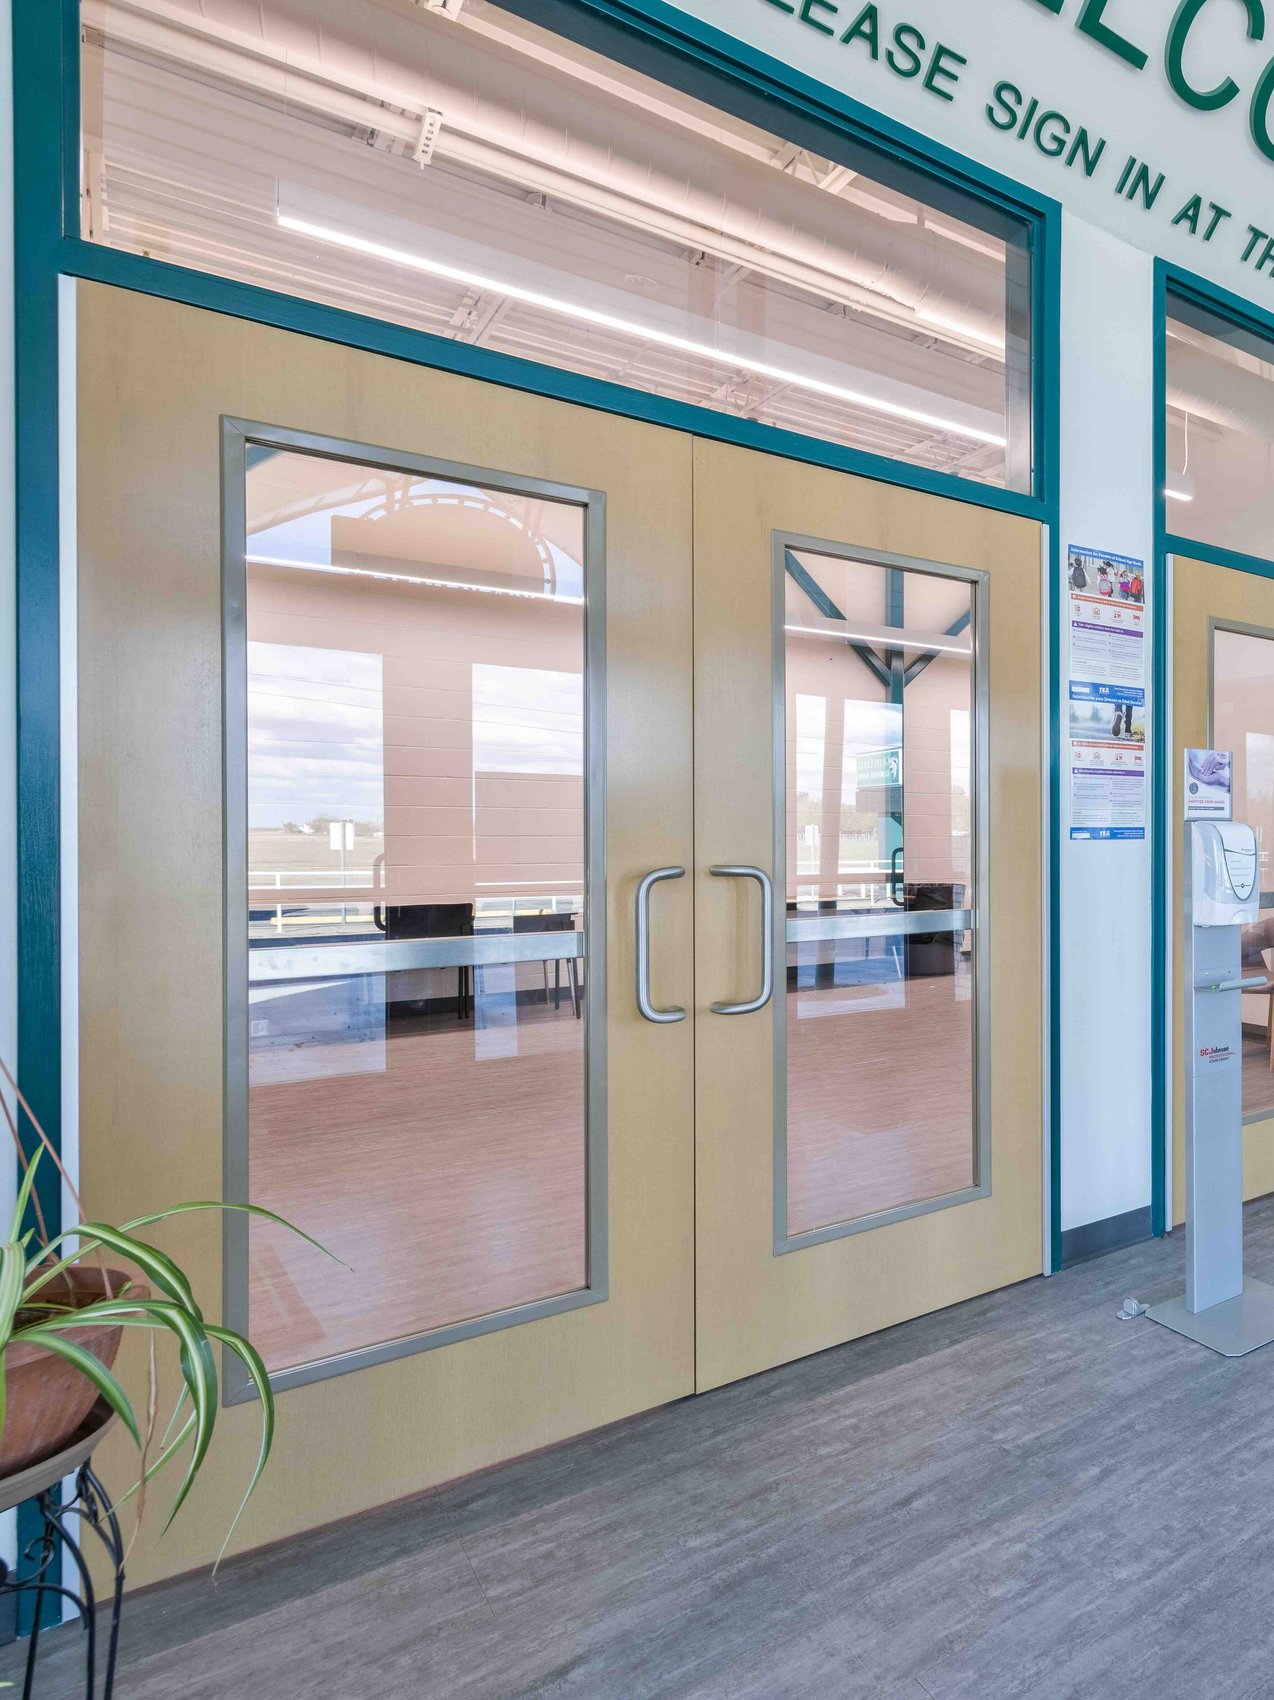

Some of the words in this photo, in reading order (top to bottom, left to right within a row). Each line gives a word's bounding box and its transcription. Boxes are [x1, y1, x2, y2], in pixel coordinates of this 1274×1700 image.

[758, 0, 968, 103] EASE
[985, 80, 1107, 177] SIGN
[1114, 154, 1166, 211] IN
[1171, 193, 1232, 242] AT
